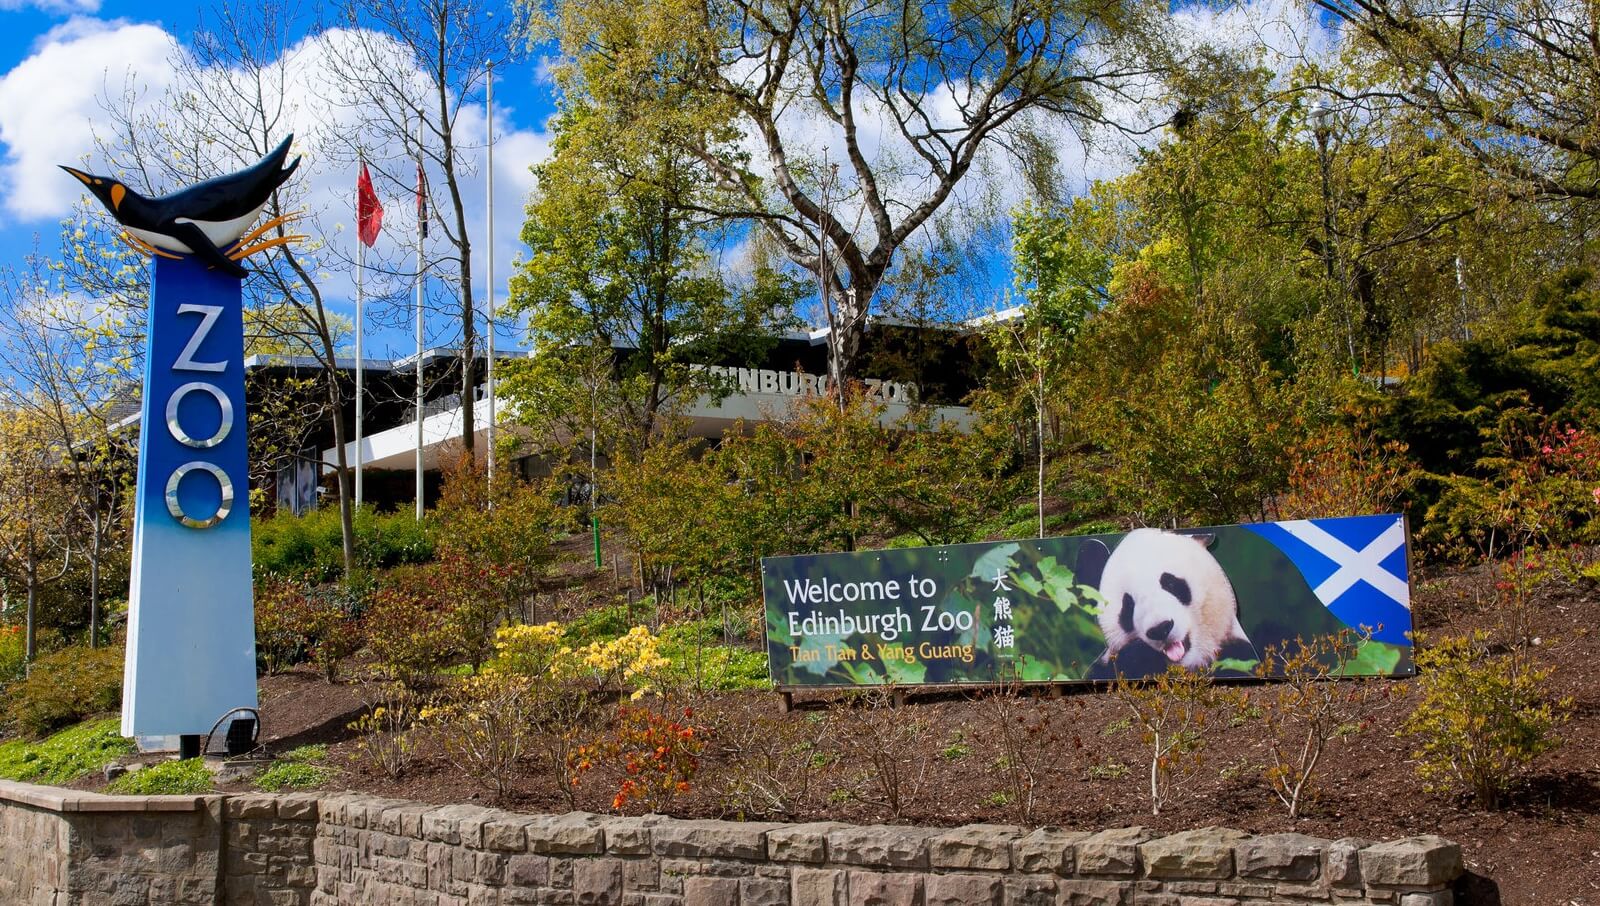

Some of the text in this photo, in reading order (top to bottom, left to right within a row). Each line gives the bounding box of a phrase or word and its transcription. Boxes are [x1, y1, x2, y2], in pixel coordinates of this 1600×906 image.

[864, 378, 919, 403] ZOO
[165, 303, 234, 529] ZOO
[783, 574, 937, 604] Welcome to
[788, 605, 973, 641] Edinburgh Zoo
[992, 567, 1014, 649] 大熊猫
[790, 642, 974, 664] Tian Tian & Yang Guang
